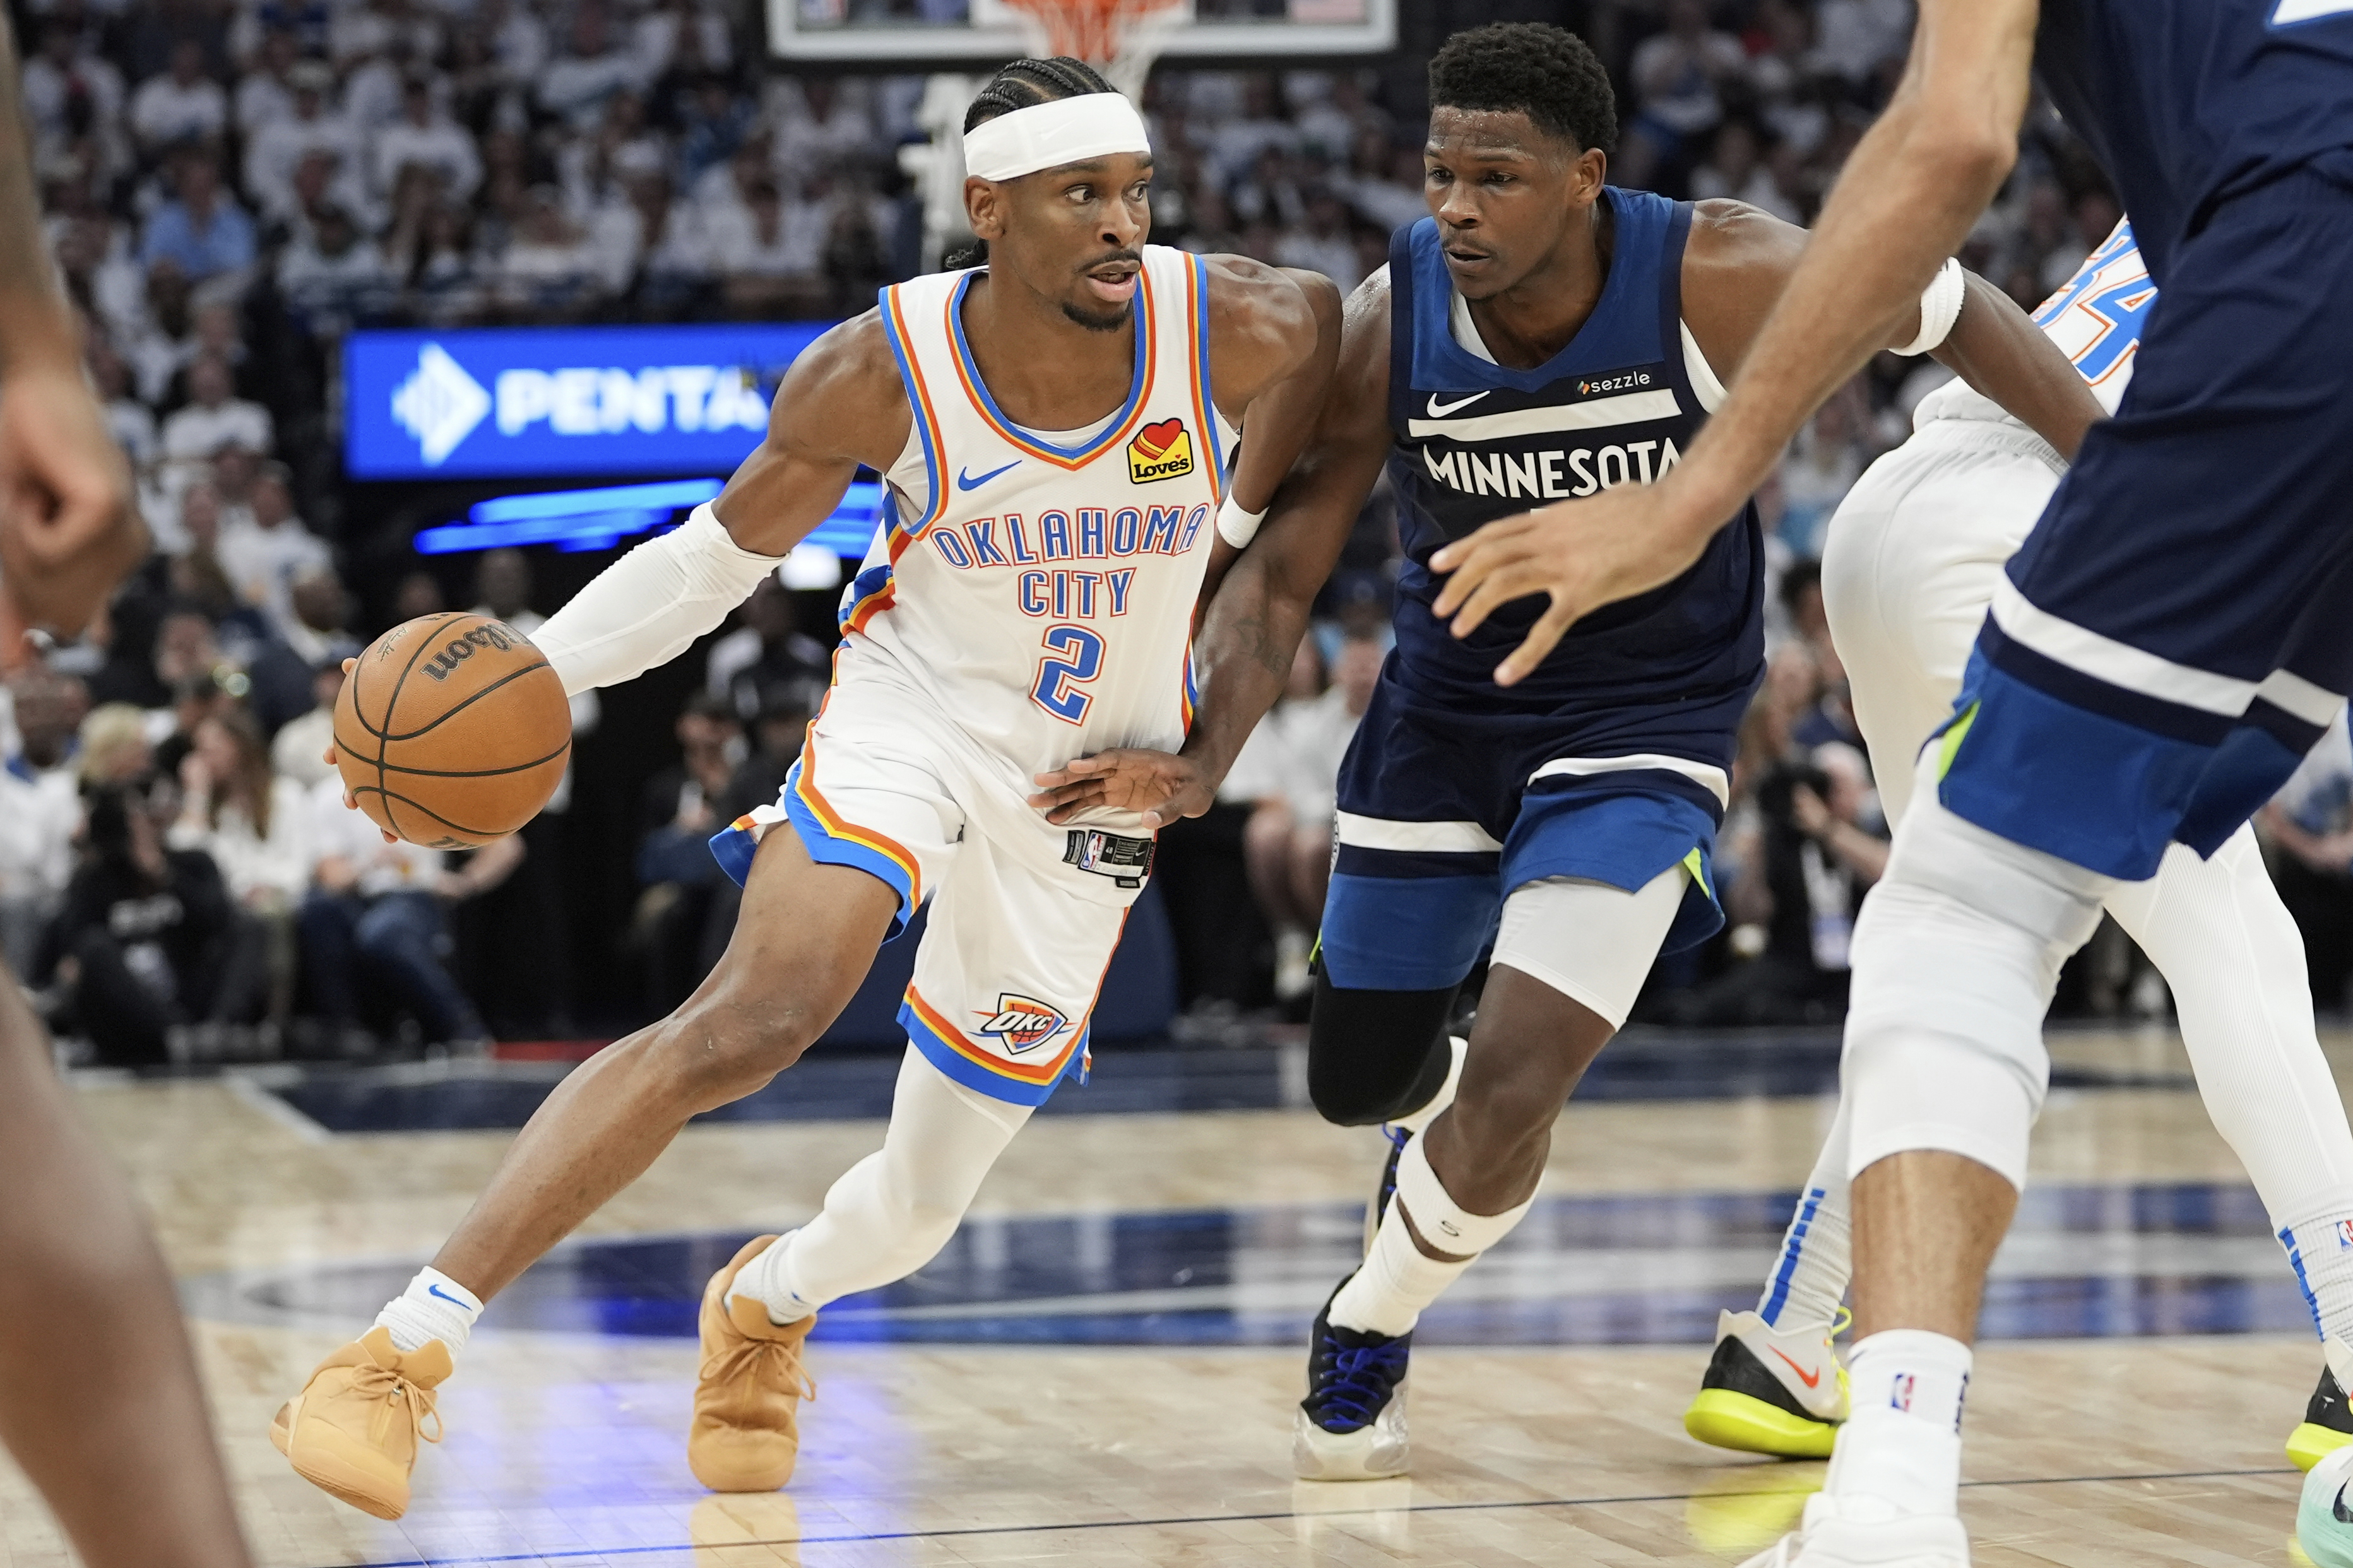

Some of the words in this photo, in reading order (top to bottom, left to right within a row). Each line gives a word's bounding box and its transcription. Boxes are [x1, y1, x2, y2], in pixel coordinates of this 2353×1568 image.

[1591, 370, 1651, 393] sezzle
[1423, 437, 1683, 498] MINNESOTA
[930, 503, 1210, 569] OKLAHOMA
[1018, 567, 1137, 619] CITY
[1029, 623, 1106, 726] 2
[981, 1010, 1054, 1032] OKC
